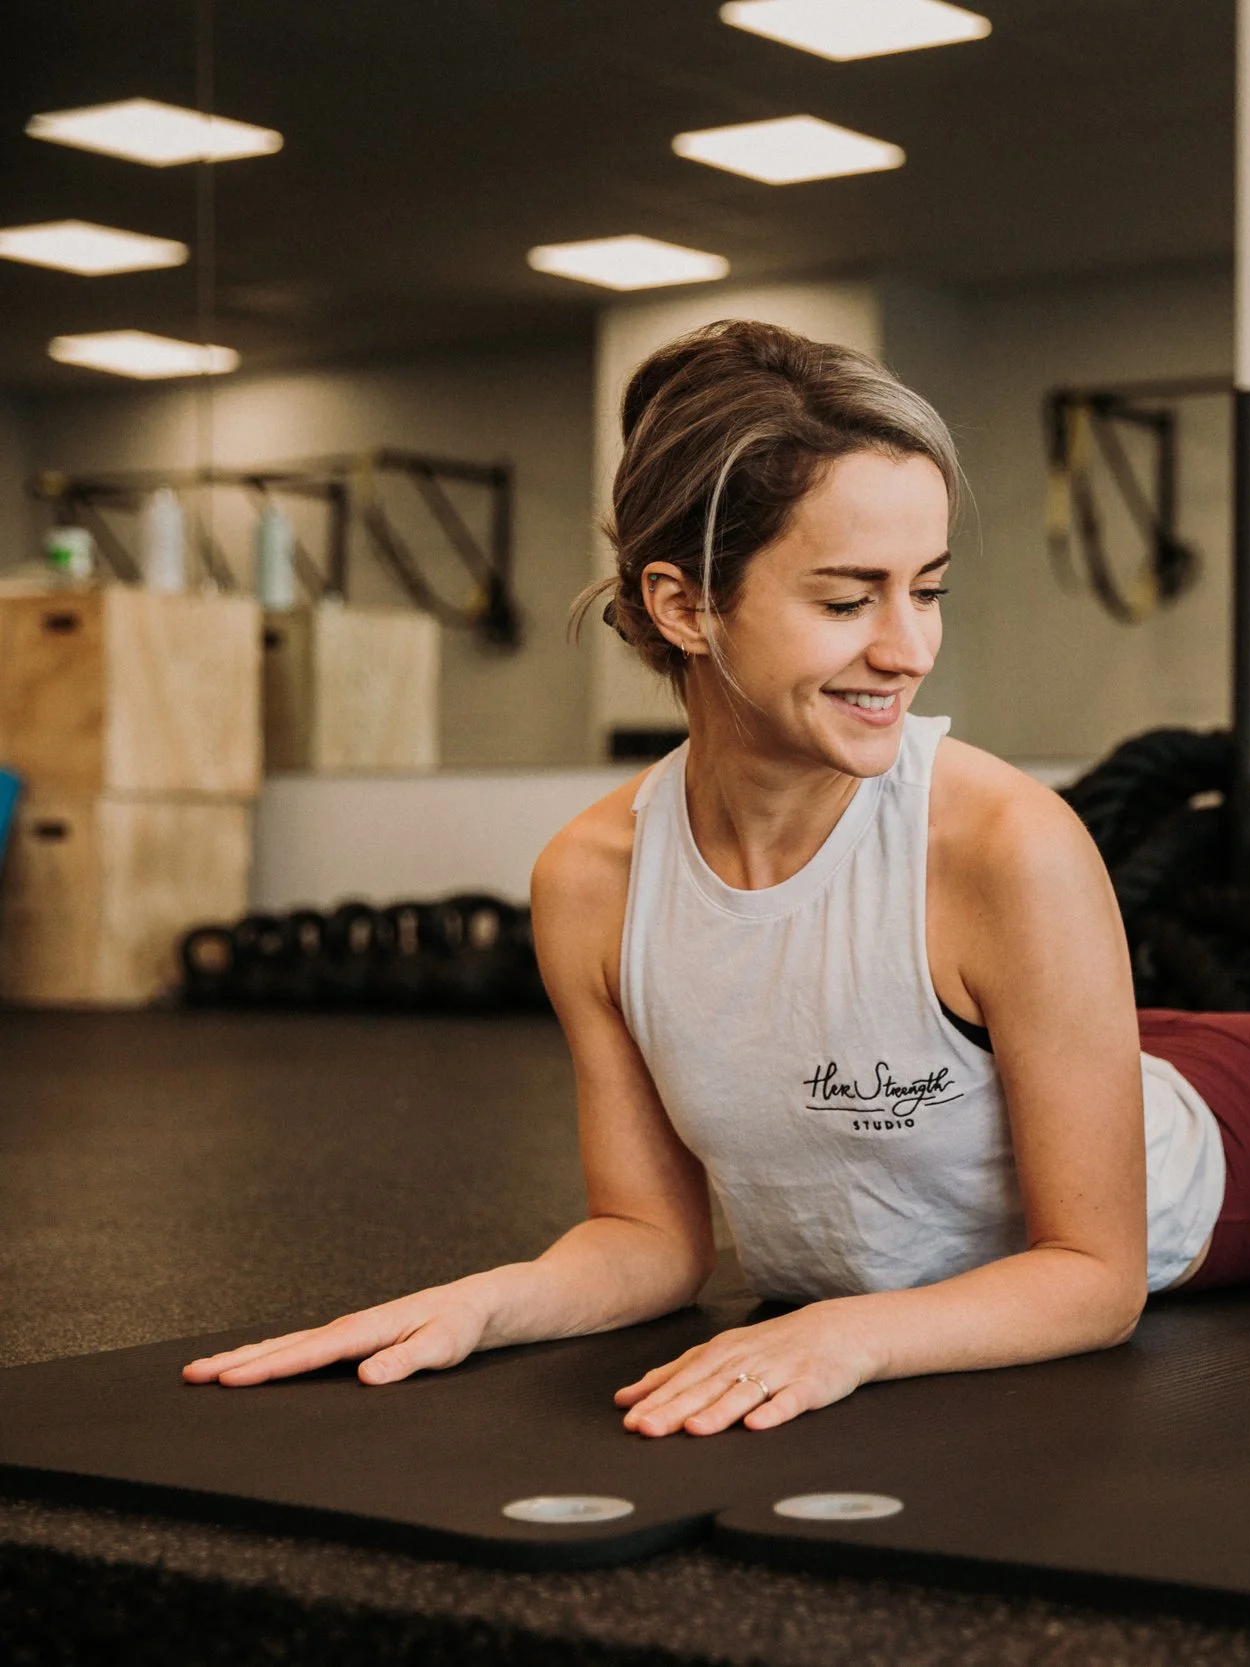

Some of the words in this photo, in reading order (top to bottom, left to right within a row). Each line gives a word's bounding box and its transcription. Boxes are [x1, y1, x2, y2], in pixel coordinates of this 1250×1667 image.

[803, 1061, 854, 1100] Her
[854, 1061, 955, 1117] Strength
[853, 1118, 915, 1131] STUDIO
